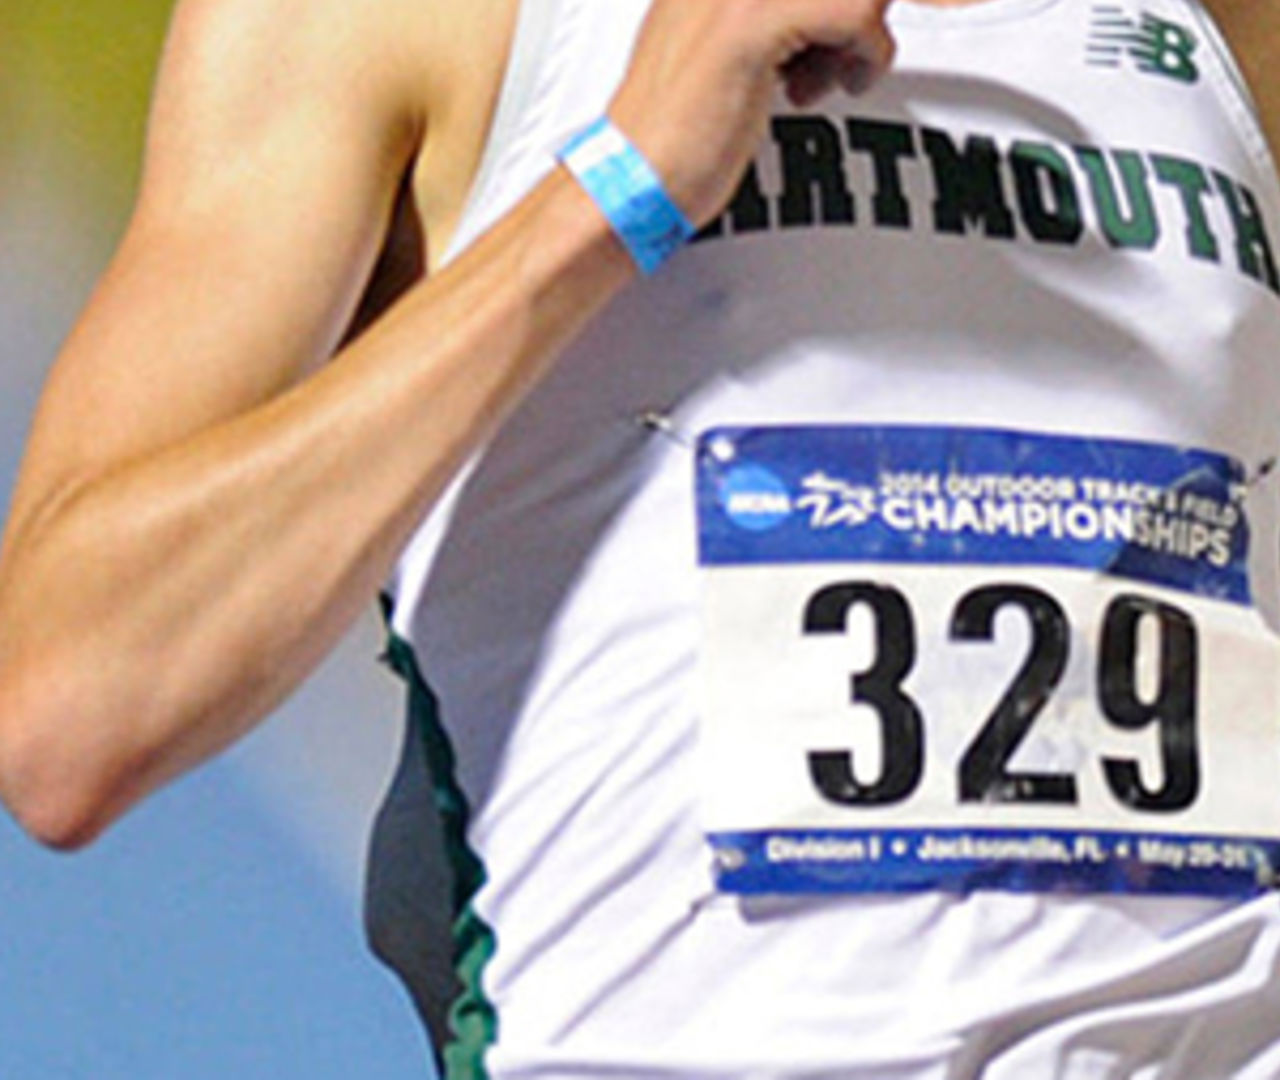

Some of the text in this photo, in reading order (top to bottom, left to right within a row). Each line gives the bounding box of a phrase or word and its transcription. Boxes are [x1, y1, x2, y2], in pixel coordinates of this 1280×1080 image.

[944, 473, 1076, 502] OUTDOOR
[881, 497, 1232, 568] CHAMPIONSHIPS
[801, 579, 1201, 814] 329
